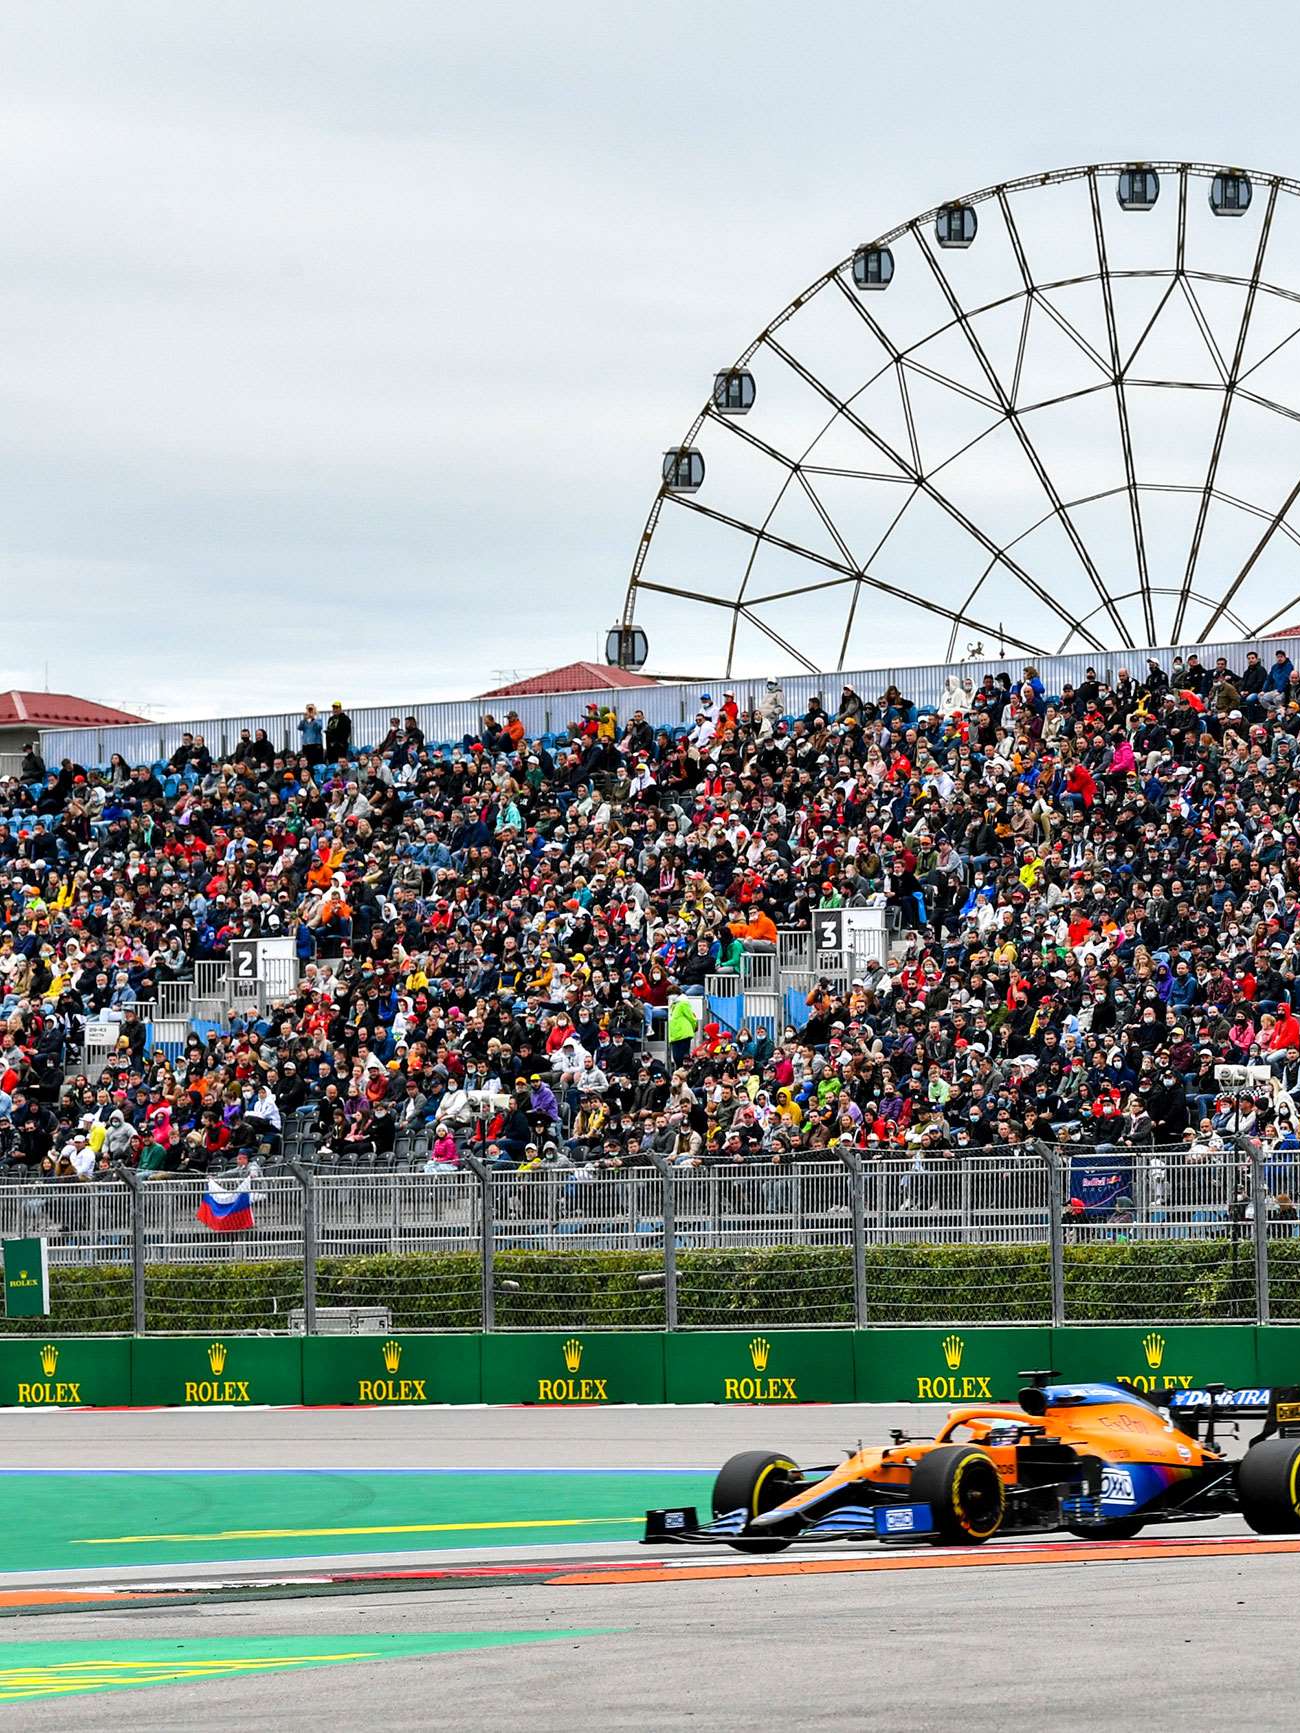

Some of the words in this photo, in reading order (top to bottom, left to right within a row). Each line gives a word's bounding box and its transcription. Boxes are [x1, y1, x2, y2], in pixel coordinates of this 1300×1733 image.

[821, 921, 837, 948] 3
[238, 951, 252, 977] 2
[18, 1383, 81, 1402] ROLEX
[186, 1382, 249, 1402] ROLEX
[359, 1380, 425, 1401] ROLEX
[538, 1379, 607, 1400] ROLEX
[725, 1378, 796, 1399] ROLEX
[917, 1377, 991, 1398] ROLEX
